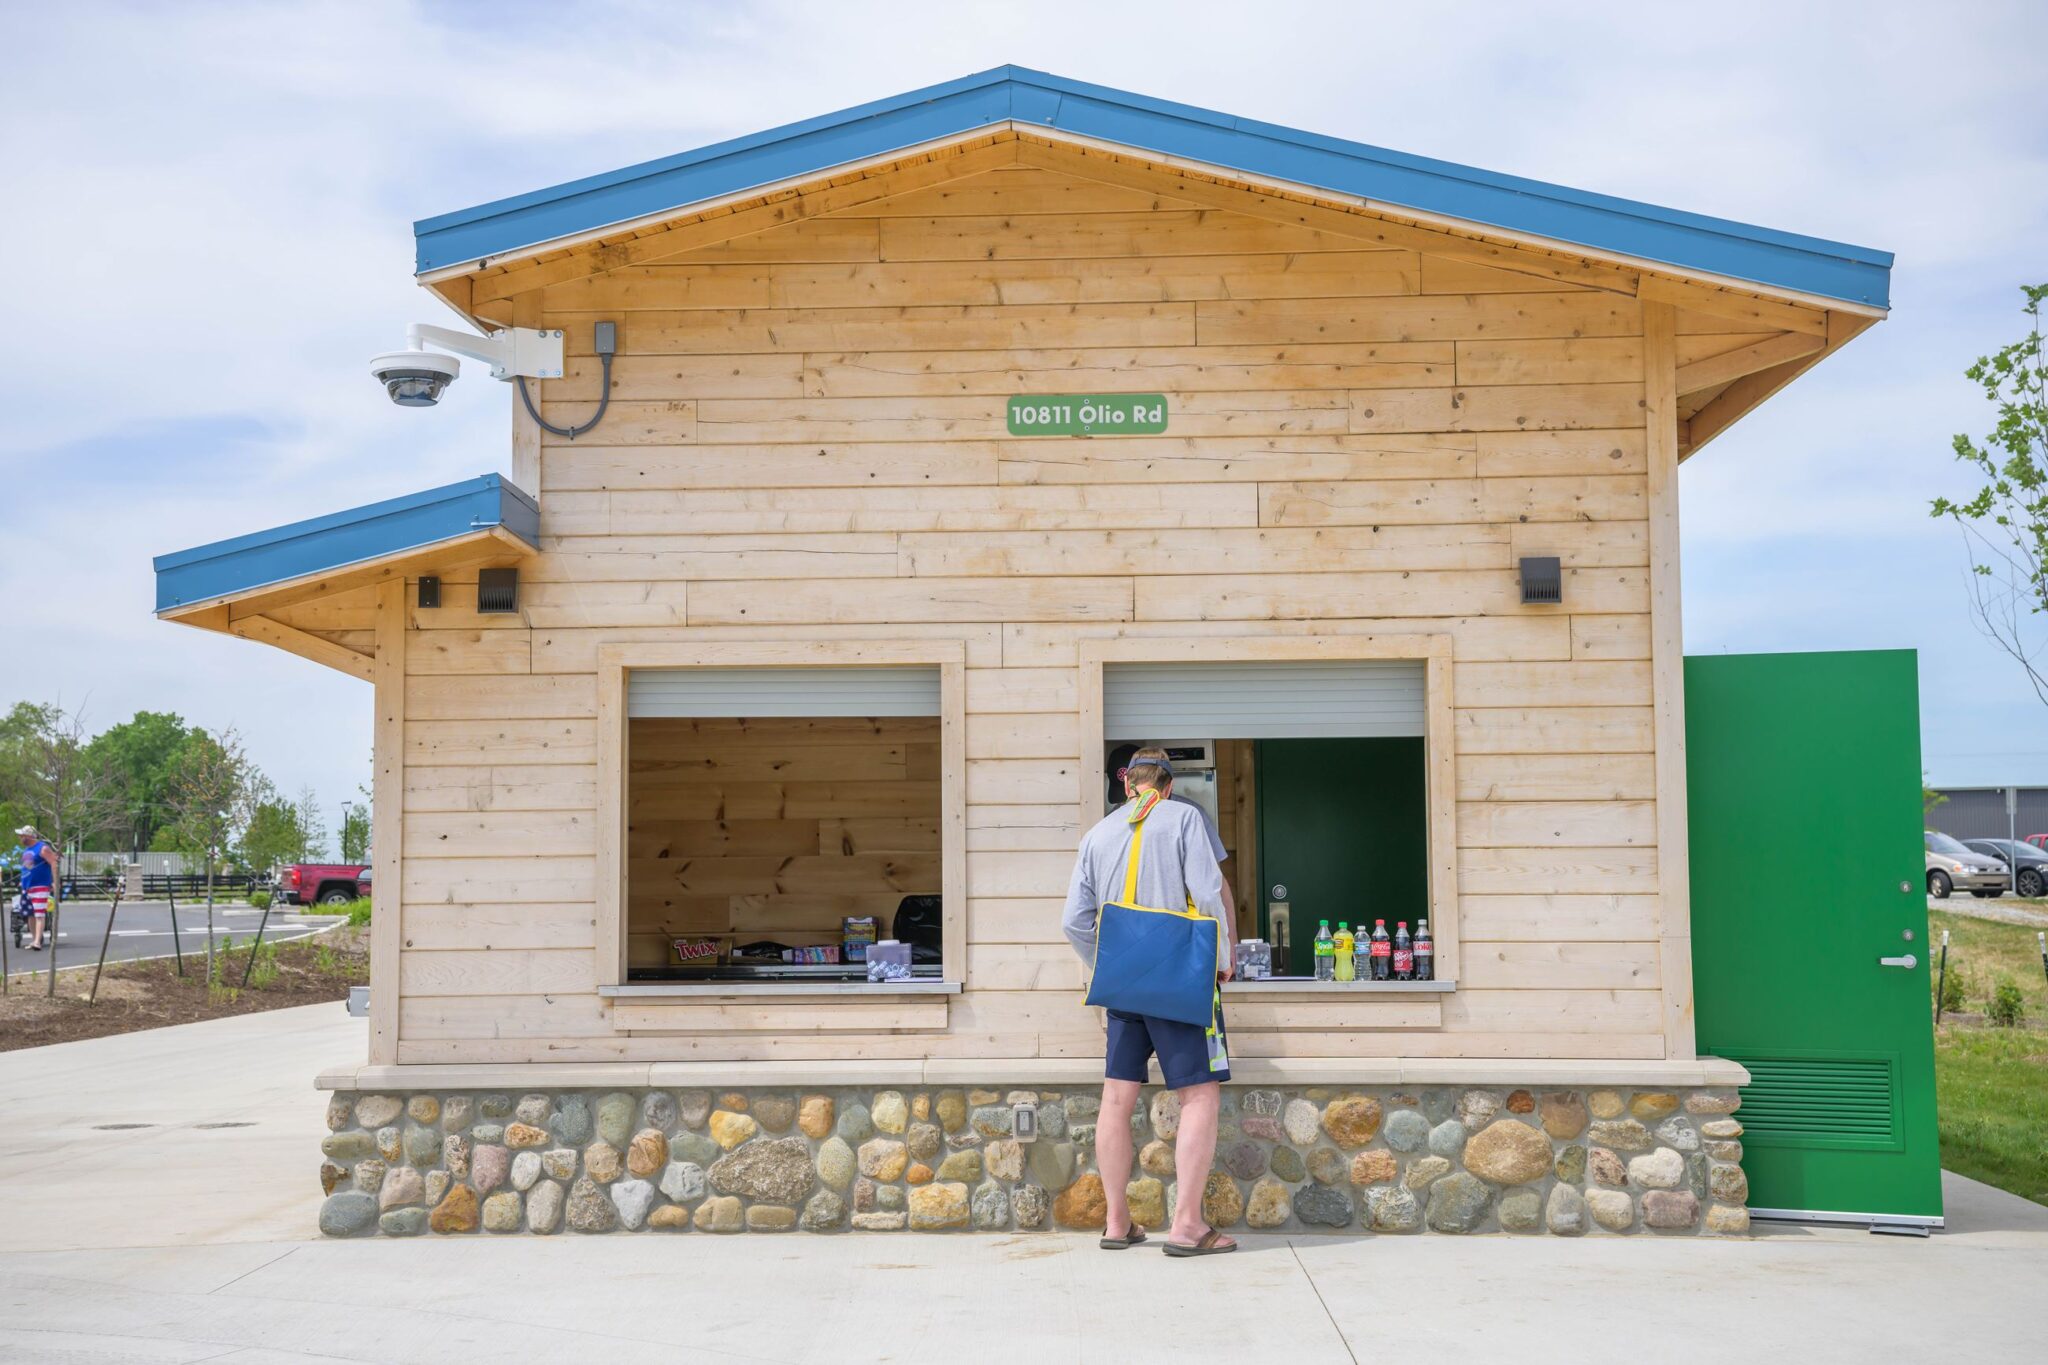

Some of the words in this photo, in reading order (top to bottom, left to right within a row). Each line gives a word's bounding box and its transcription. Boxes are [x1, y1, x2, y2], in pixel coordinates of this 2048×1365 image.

[1012, 405, 1071, 425] 10811
[1078, 405, 1125, 424] Olio
[1133, 404, 1162, 423] Rd
